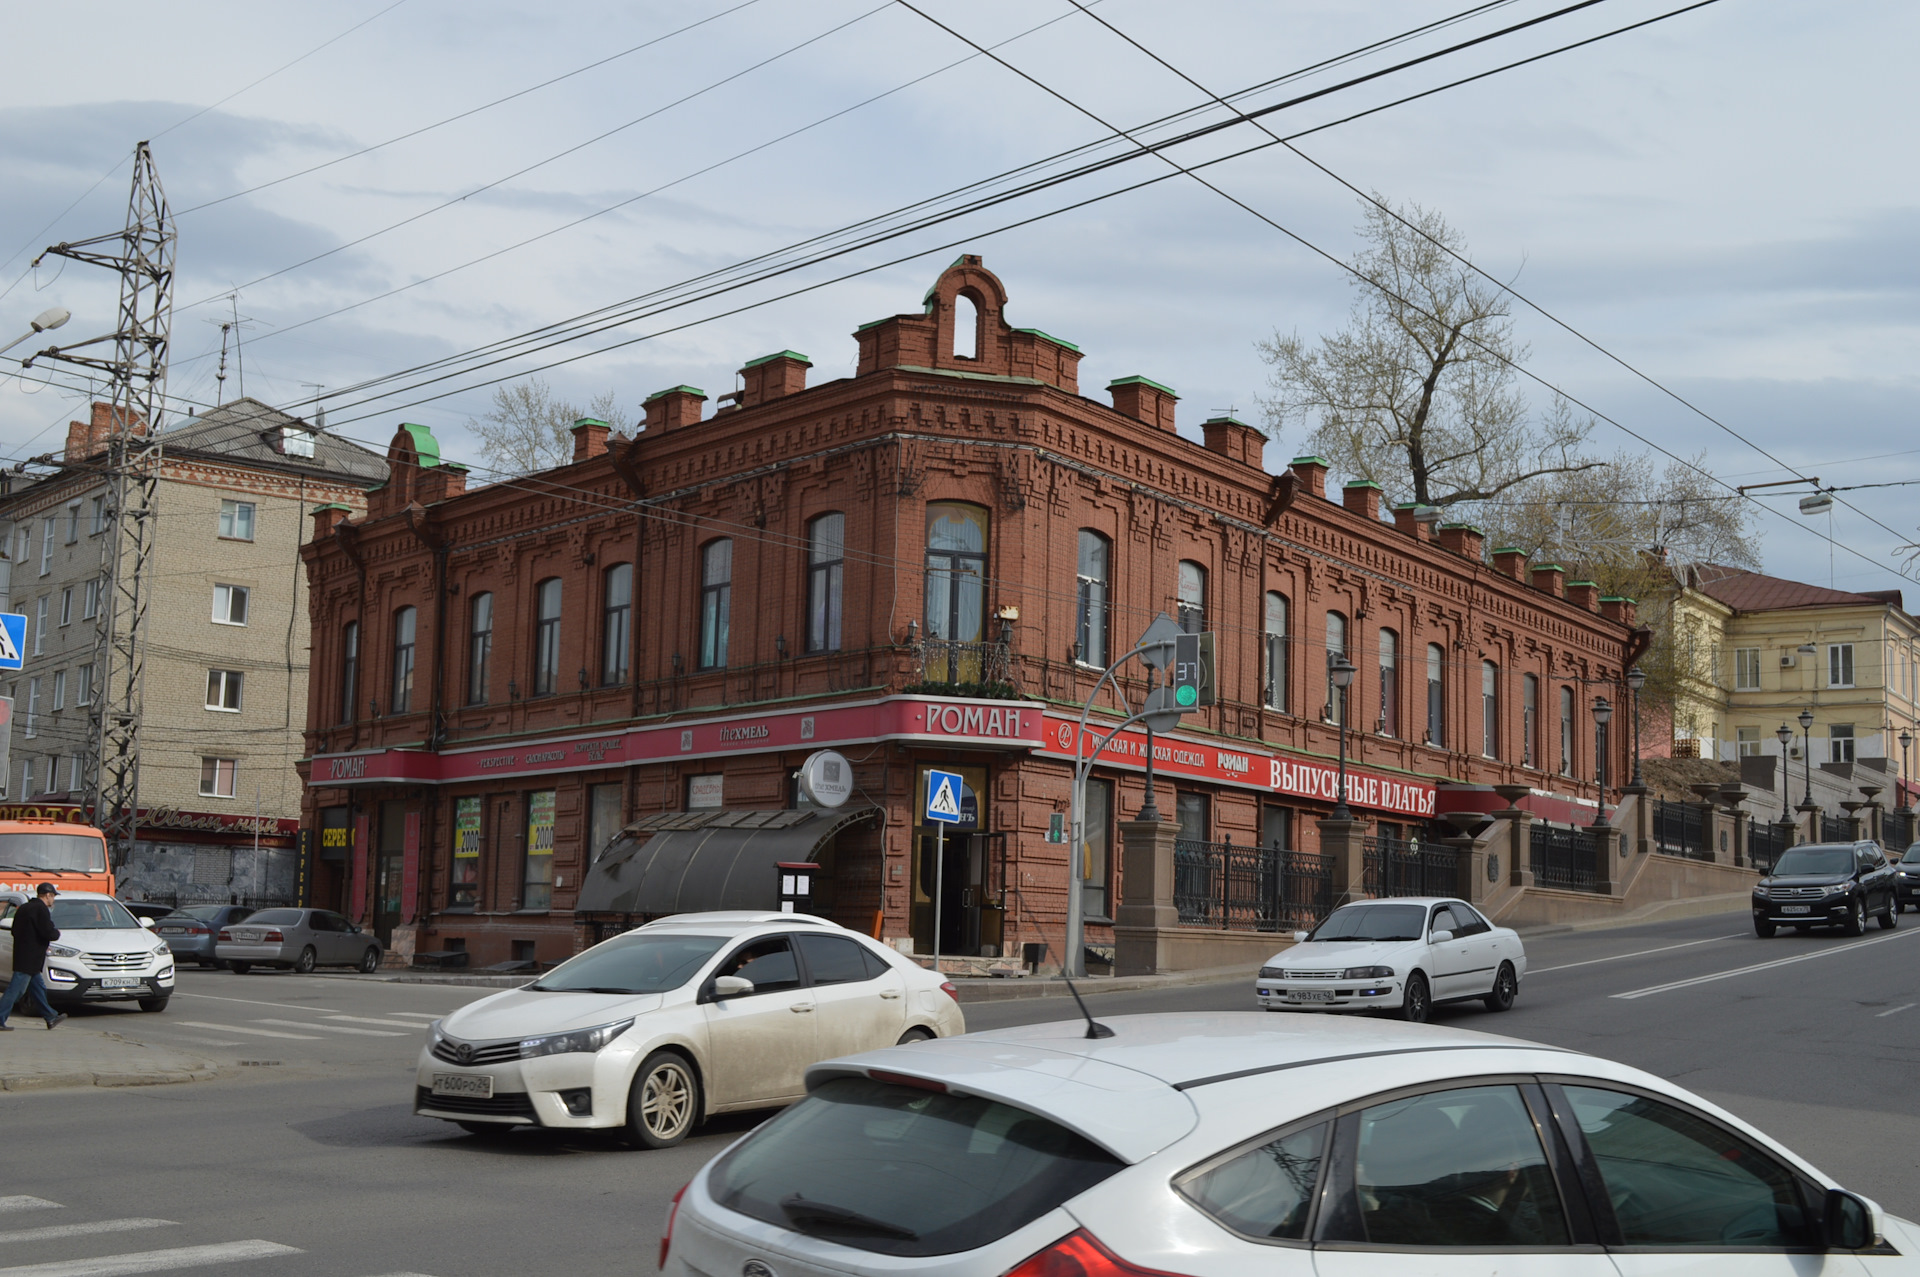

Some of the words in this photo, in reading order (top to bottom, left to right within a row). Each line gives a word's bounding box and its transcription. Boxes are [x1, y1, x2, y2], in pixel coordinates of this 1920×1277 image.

[1177, 662, 1197, 681] 37
[926, 704, 1020, 737] РОМАН
[1130, 742, 1136, 756] И
[1138, 743, 1171, 763] ЖСКАЯ
[1173, 749, 1205, 768] ОДЕЖДА
[1217, 752, 1249, 773] РОМАН
[332, 757, 365, 778] РОМАН
[1270, 759, 1378, 806] ВЫПУСКНЫЕ
[1381, 780, 1437, 815] ПЛАТЬЯ
[322, 828, 356, 847] СЕРЕБ
[462, 829, 479, 853] 2000
[535, 825, 553, 850] 2000
[12, 883, 59, 893] ГРАТ
